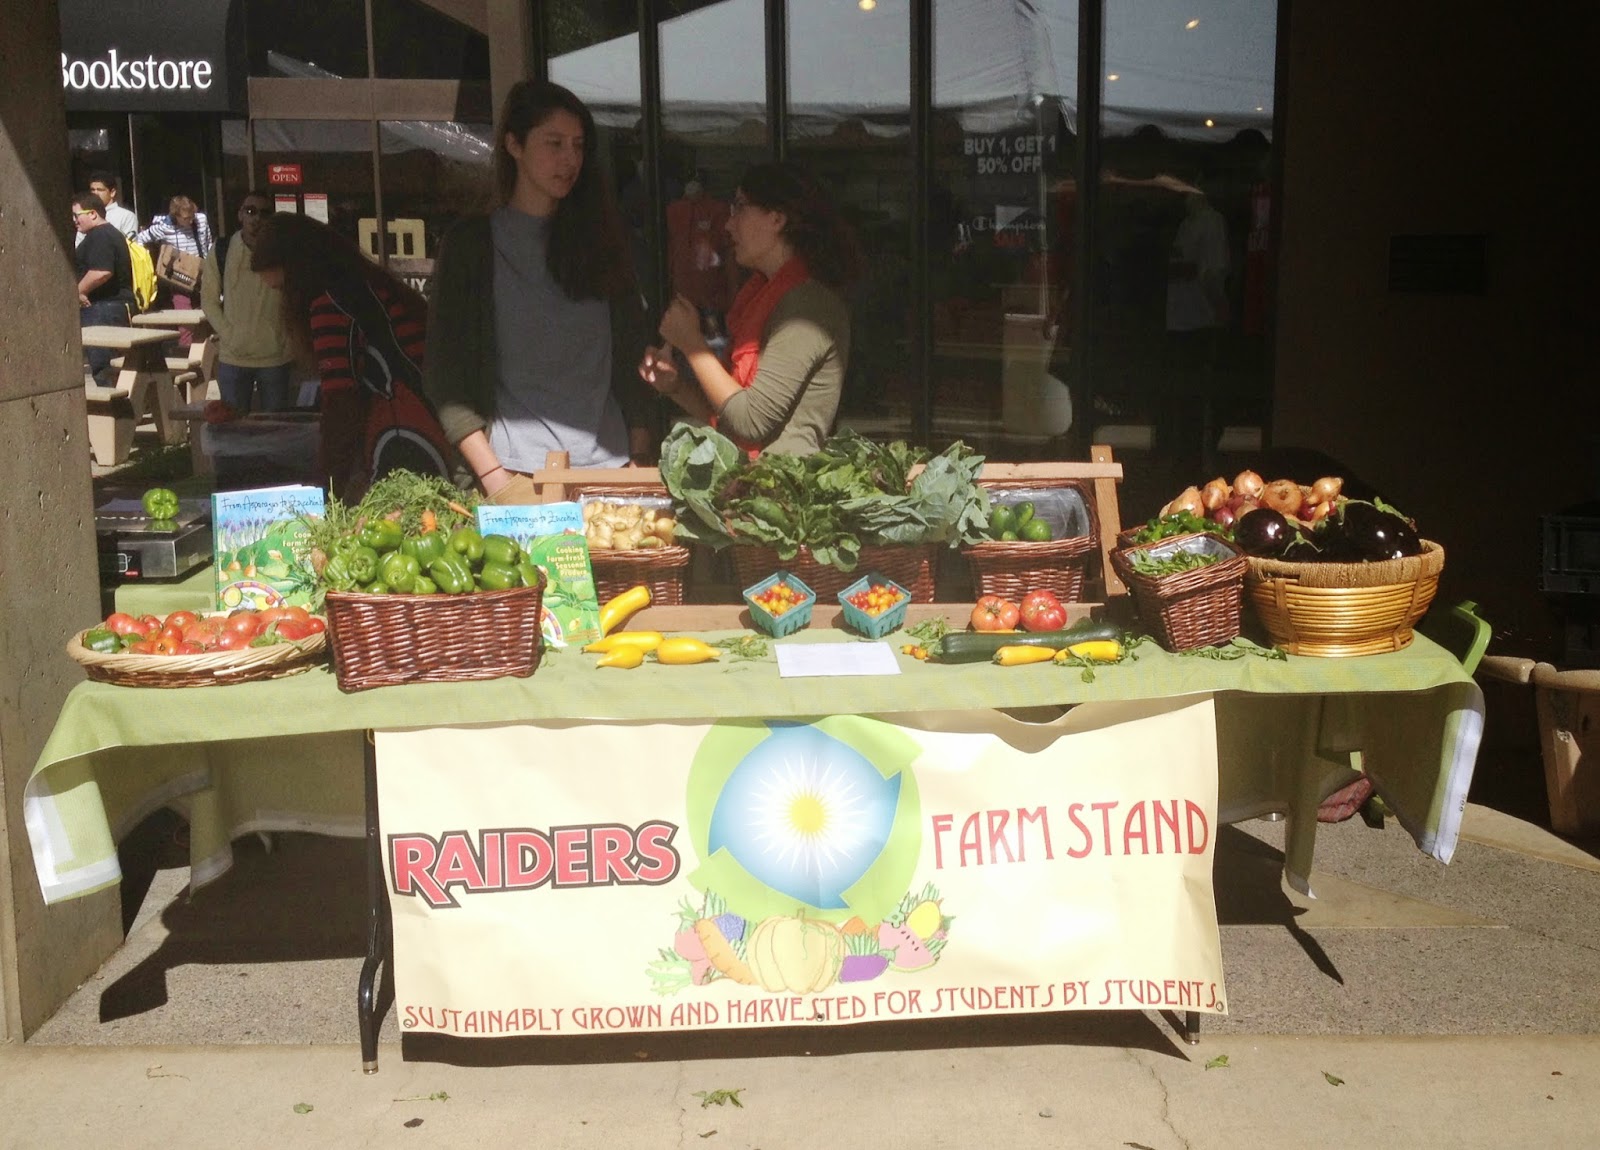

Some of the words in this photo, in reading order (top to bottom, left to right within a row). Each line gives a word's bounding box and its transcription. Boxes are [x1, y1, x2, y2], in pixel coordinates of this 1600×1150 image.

[964, 138, 995, 155] BUY
[1014, 136, 1044, 153] GET
[1048, 135, 1056, 152] 1
[977, 157, 1007, 174] 50%
[1011, 155, 1042, 173] OFF
[272, 173, 298, 182] OPEN
[221, 498, 243, 511] From
[244, 495, 279, 512] Asparagus
[483, 511, 503, 522] From
[504, 509, 538, 528] Asparagus
[546, 554, 585, 562] Farm-Fresh
[556, 546, 584, 555] Cooking
[555, 562, 586, 570] Seasonal
[931, 806, 1055, 869] FARM
[1066, 798, 1208, 859] STAND
[387, 819, 681, 909] RAIDERS
[404, 1005, 564, 1033] SUSTAINABLY
[571, 1004, 662, 1031] GROWN
[670, 1000, 719, 1027] AND
[727, 995, 867, 1026] HARVESTED
[874, 990, 923, 1015] FOR
[930, 983, 1055, 1013] STUDENTS
[1062, 980, 1090, 1006] BY
